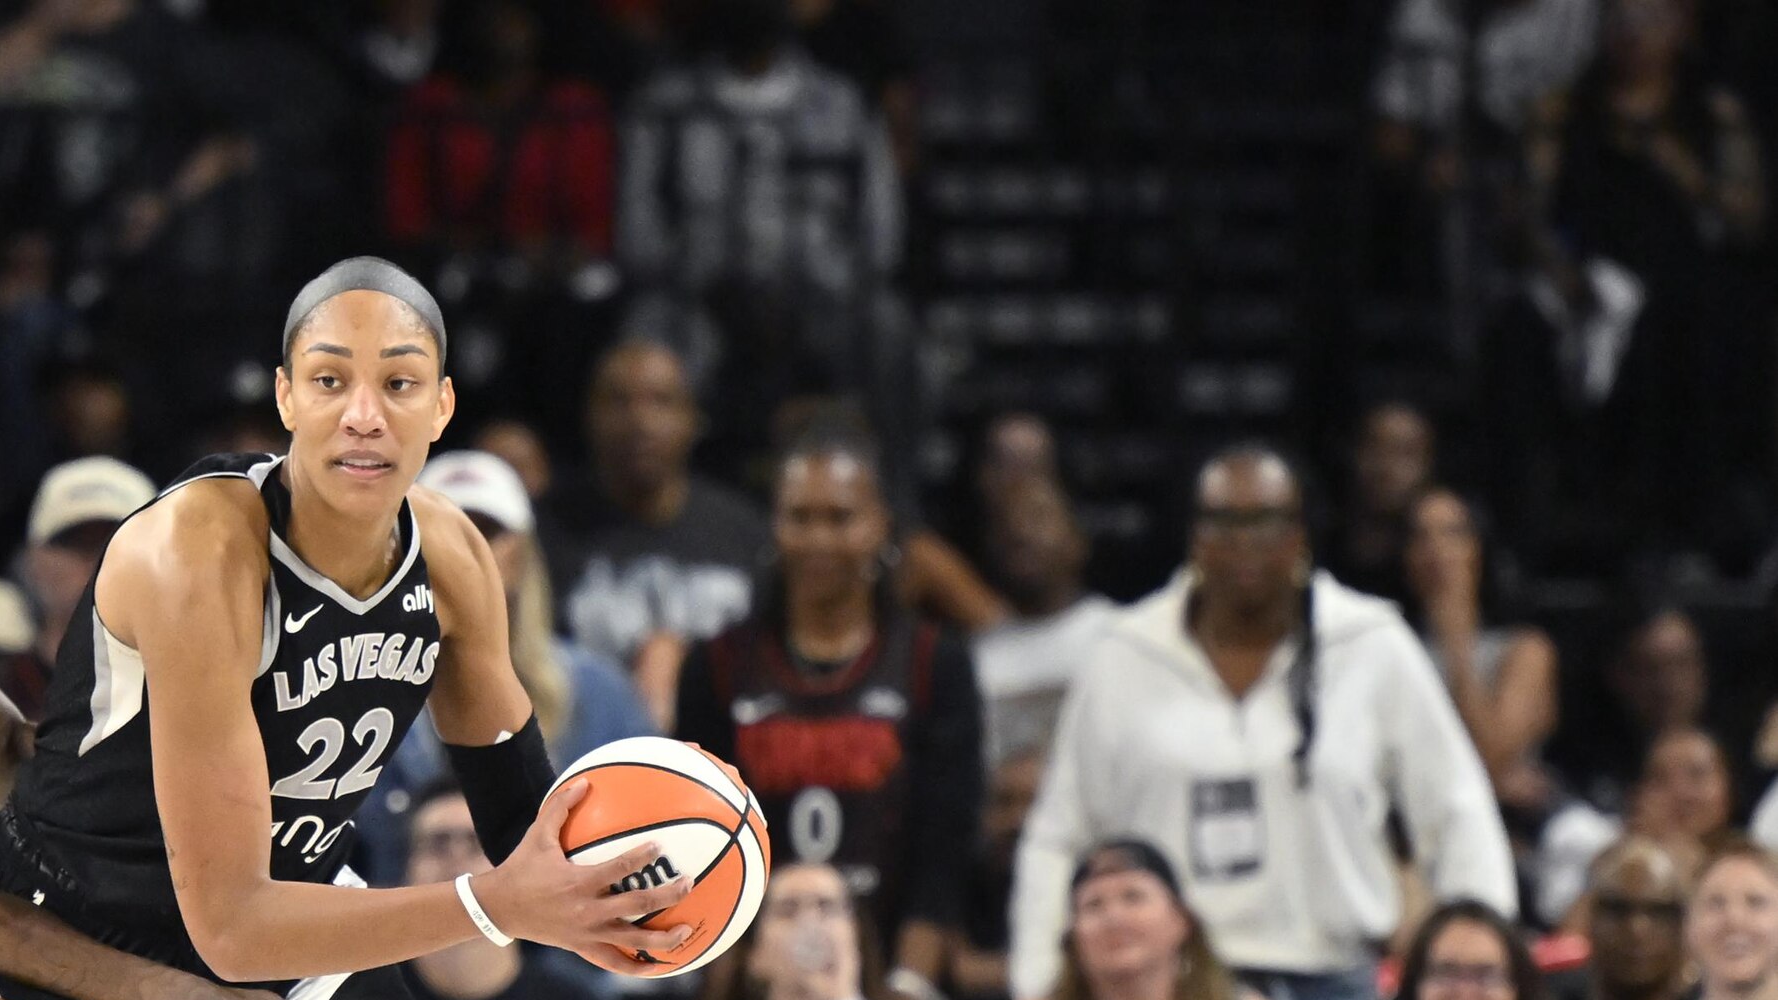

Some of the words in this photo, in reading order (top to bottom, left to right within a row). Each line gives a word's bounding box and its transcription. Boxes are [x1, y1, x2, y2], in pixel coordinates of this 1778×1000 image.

[273, 643, 338, 713] LAS
[340, 632, 441, 685] VEGAS
[270, 707, 395, 800] 22
[609, 855, 681, 895] on
